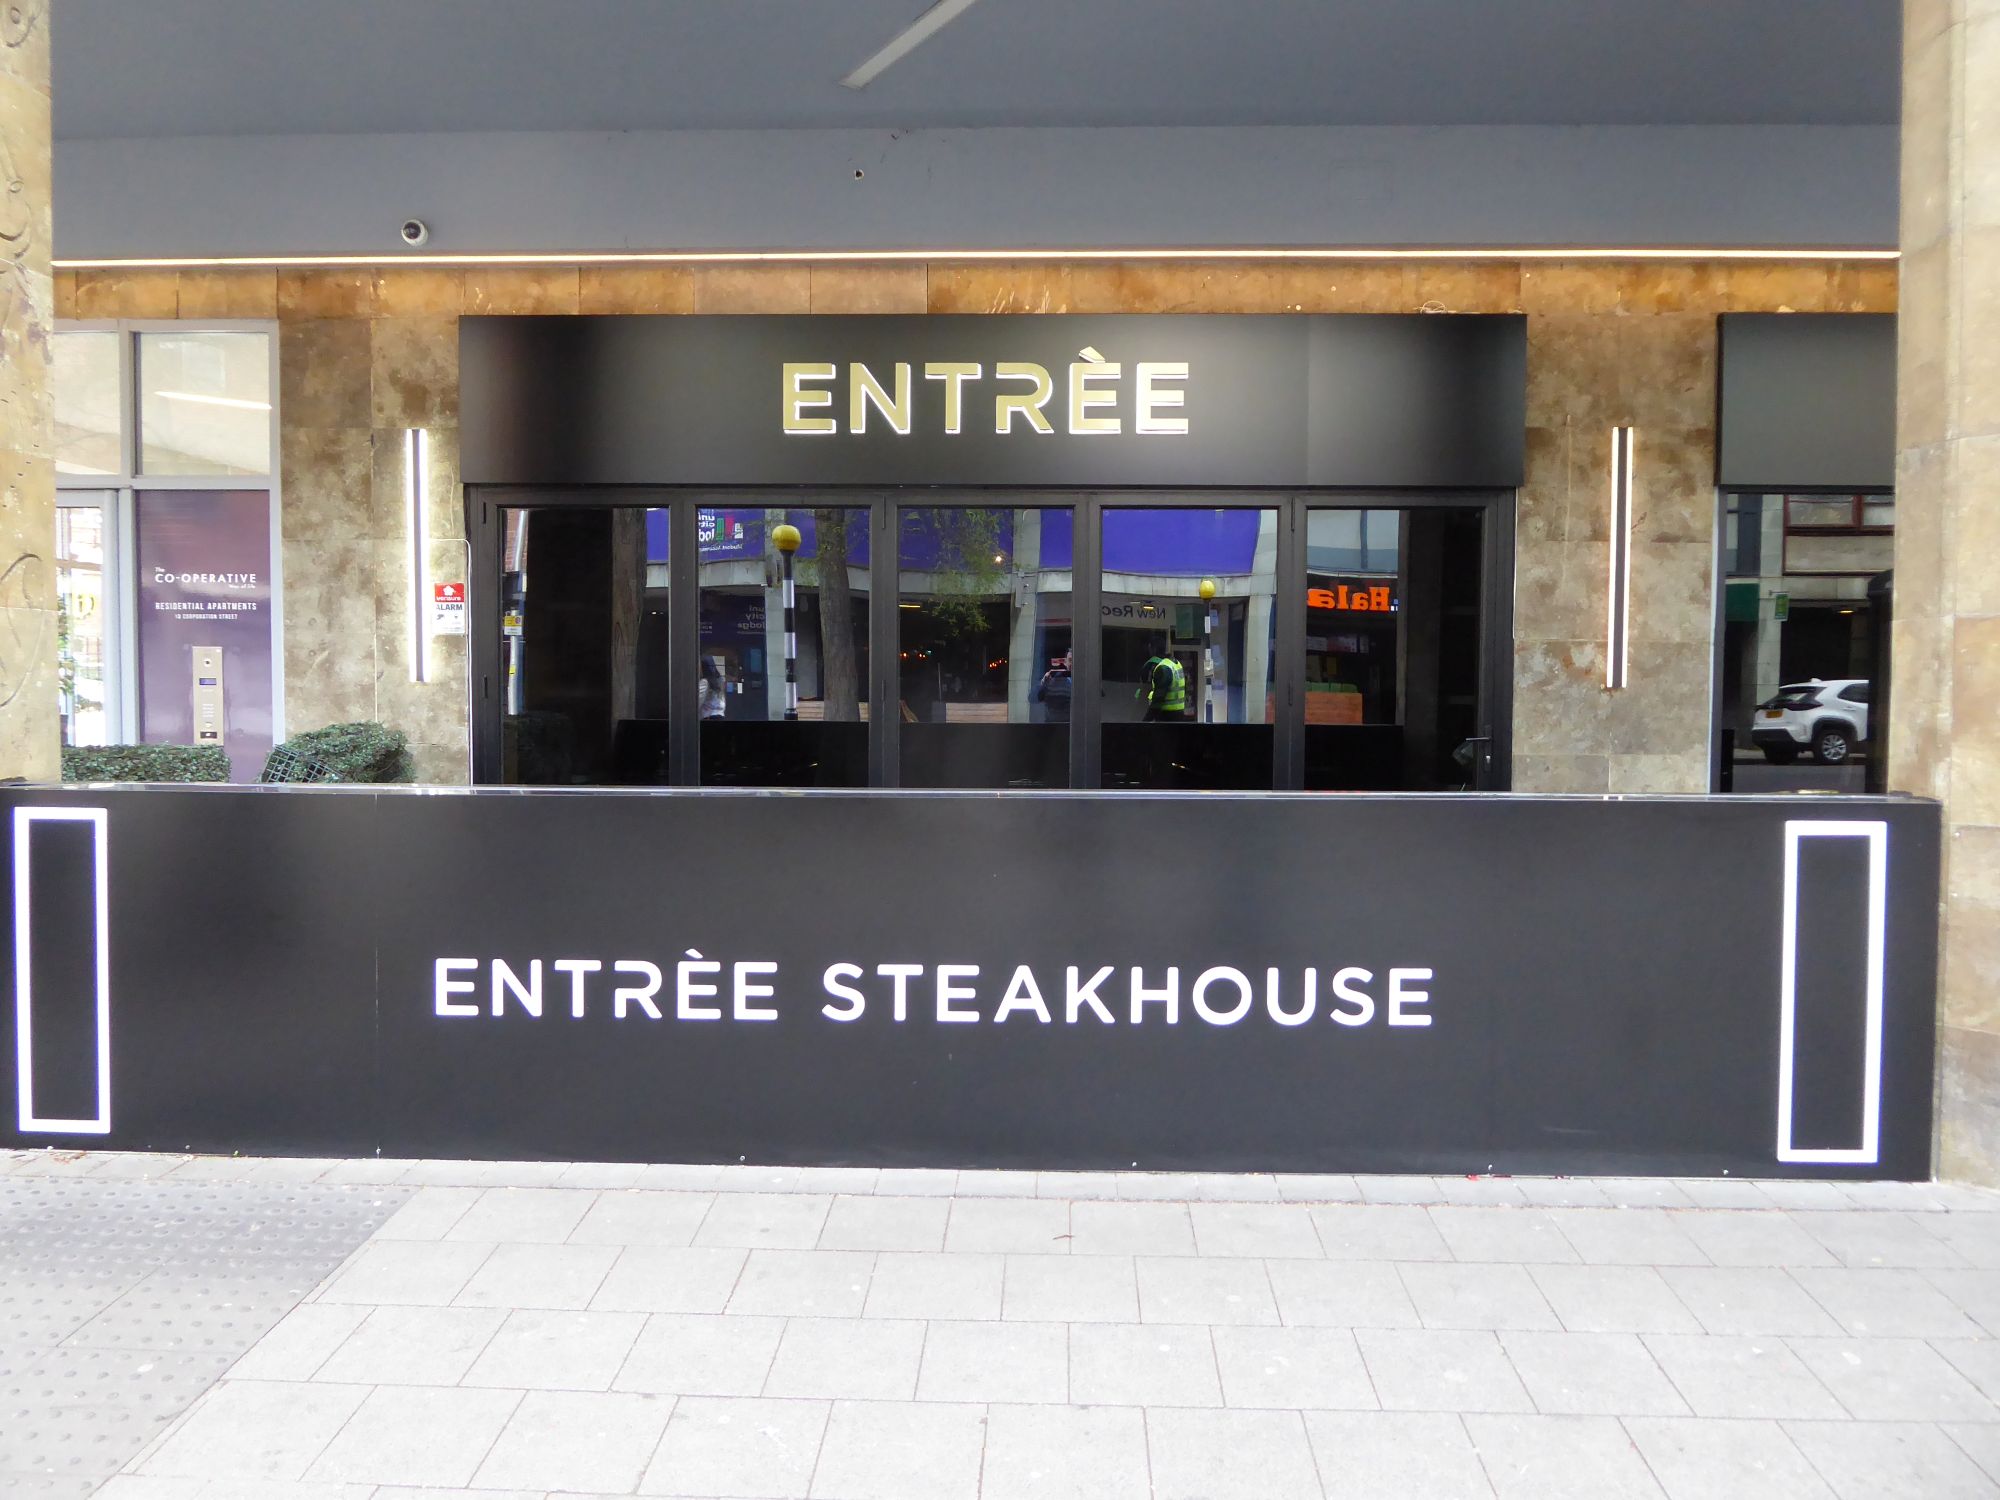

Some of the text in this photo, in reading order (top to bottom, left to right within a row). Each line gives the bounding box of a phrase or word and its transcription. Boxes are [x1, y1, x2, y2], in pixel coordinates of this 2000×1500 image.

[783, 346, 1189, 434] ENTRÈE
[155, 573, 257, 583] CO-OPERATIVE
[155, 602, 257, 610] RESIDENTIAL APARTMENTS
[436, 603, 463, 611] ALARM
[433, 948, 1433, 1028] ENTRÈE STEAKHOUSE
